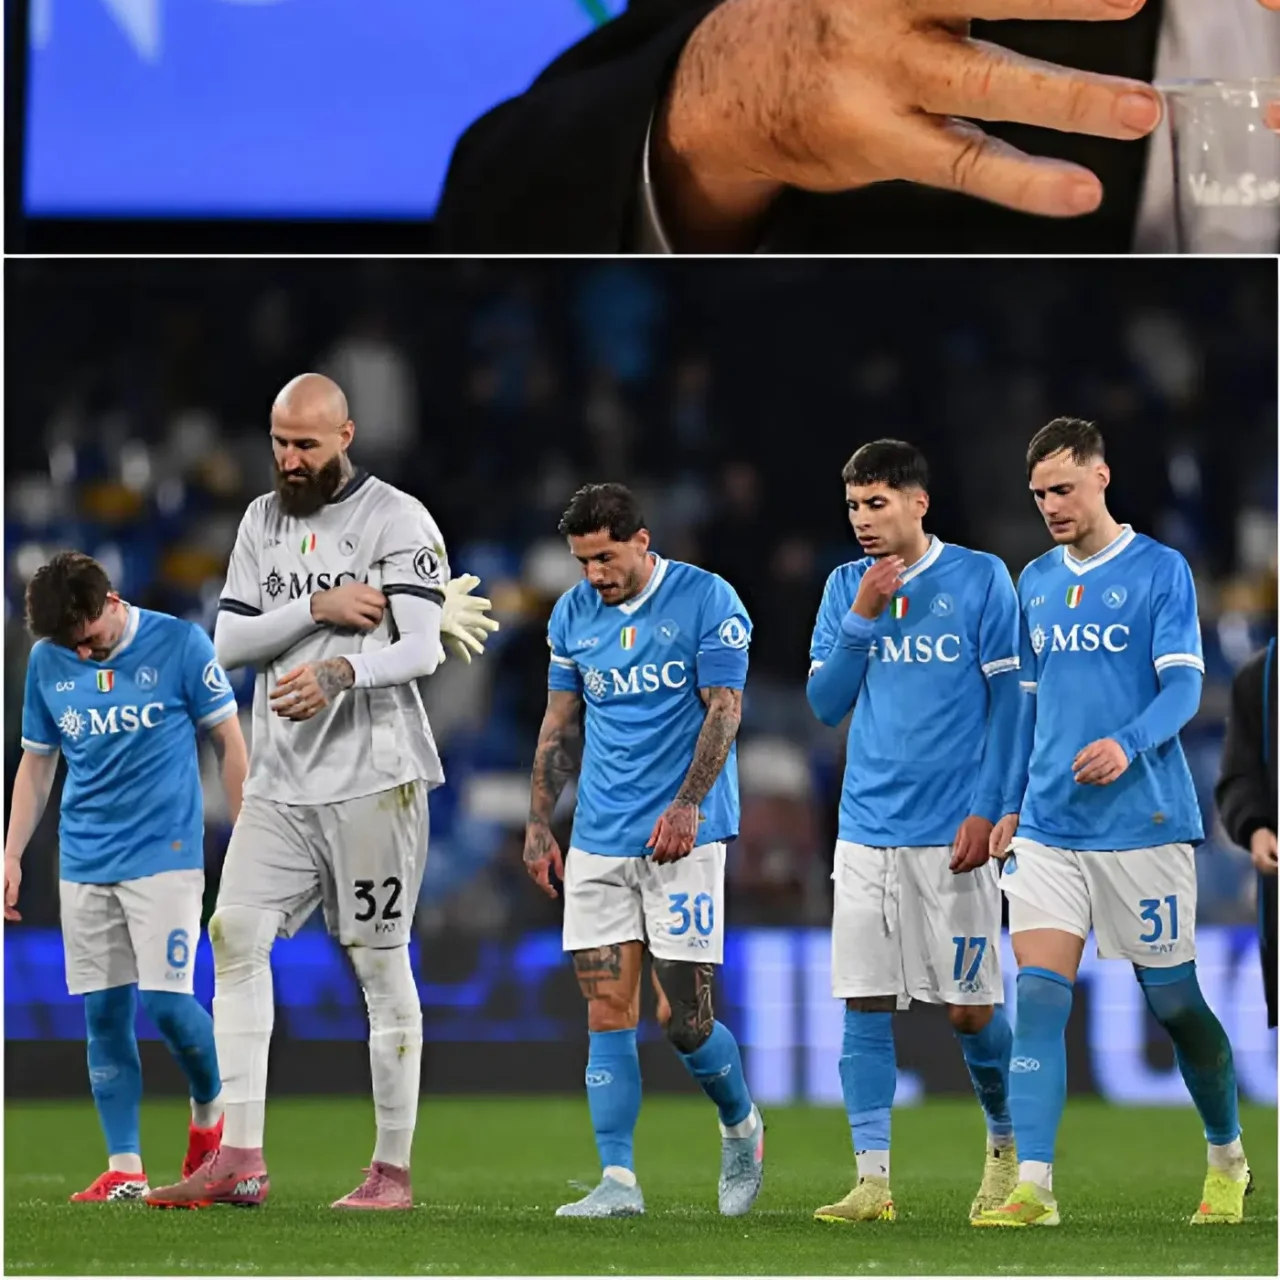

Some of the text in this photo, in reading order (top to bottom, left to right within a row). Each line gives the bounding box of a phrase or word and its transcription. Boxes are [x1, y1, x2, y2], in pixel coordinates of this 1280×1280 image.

[882, 633, 960, 663] MSC
[1051, 623, 1130, 652] MSC
[610, 660, 687, 696] MSC
[88, 702, 165, 736] MSC
[354, 876, 402, 922] 32
[668, 891, 714, 937] 30
[1139, 894, 1179, 943] 31
[166, 928, 190, 969] 6
[952, 936, 987, 981] 17
